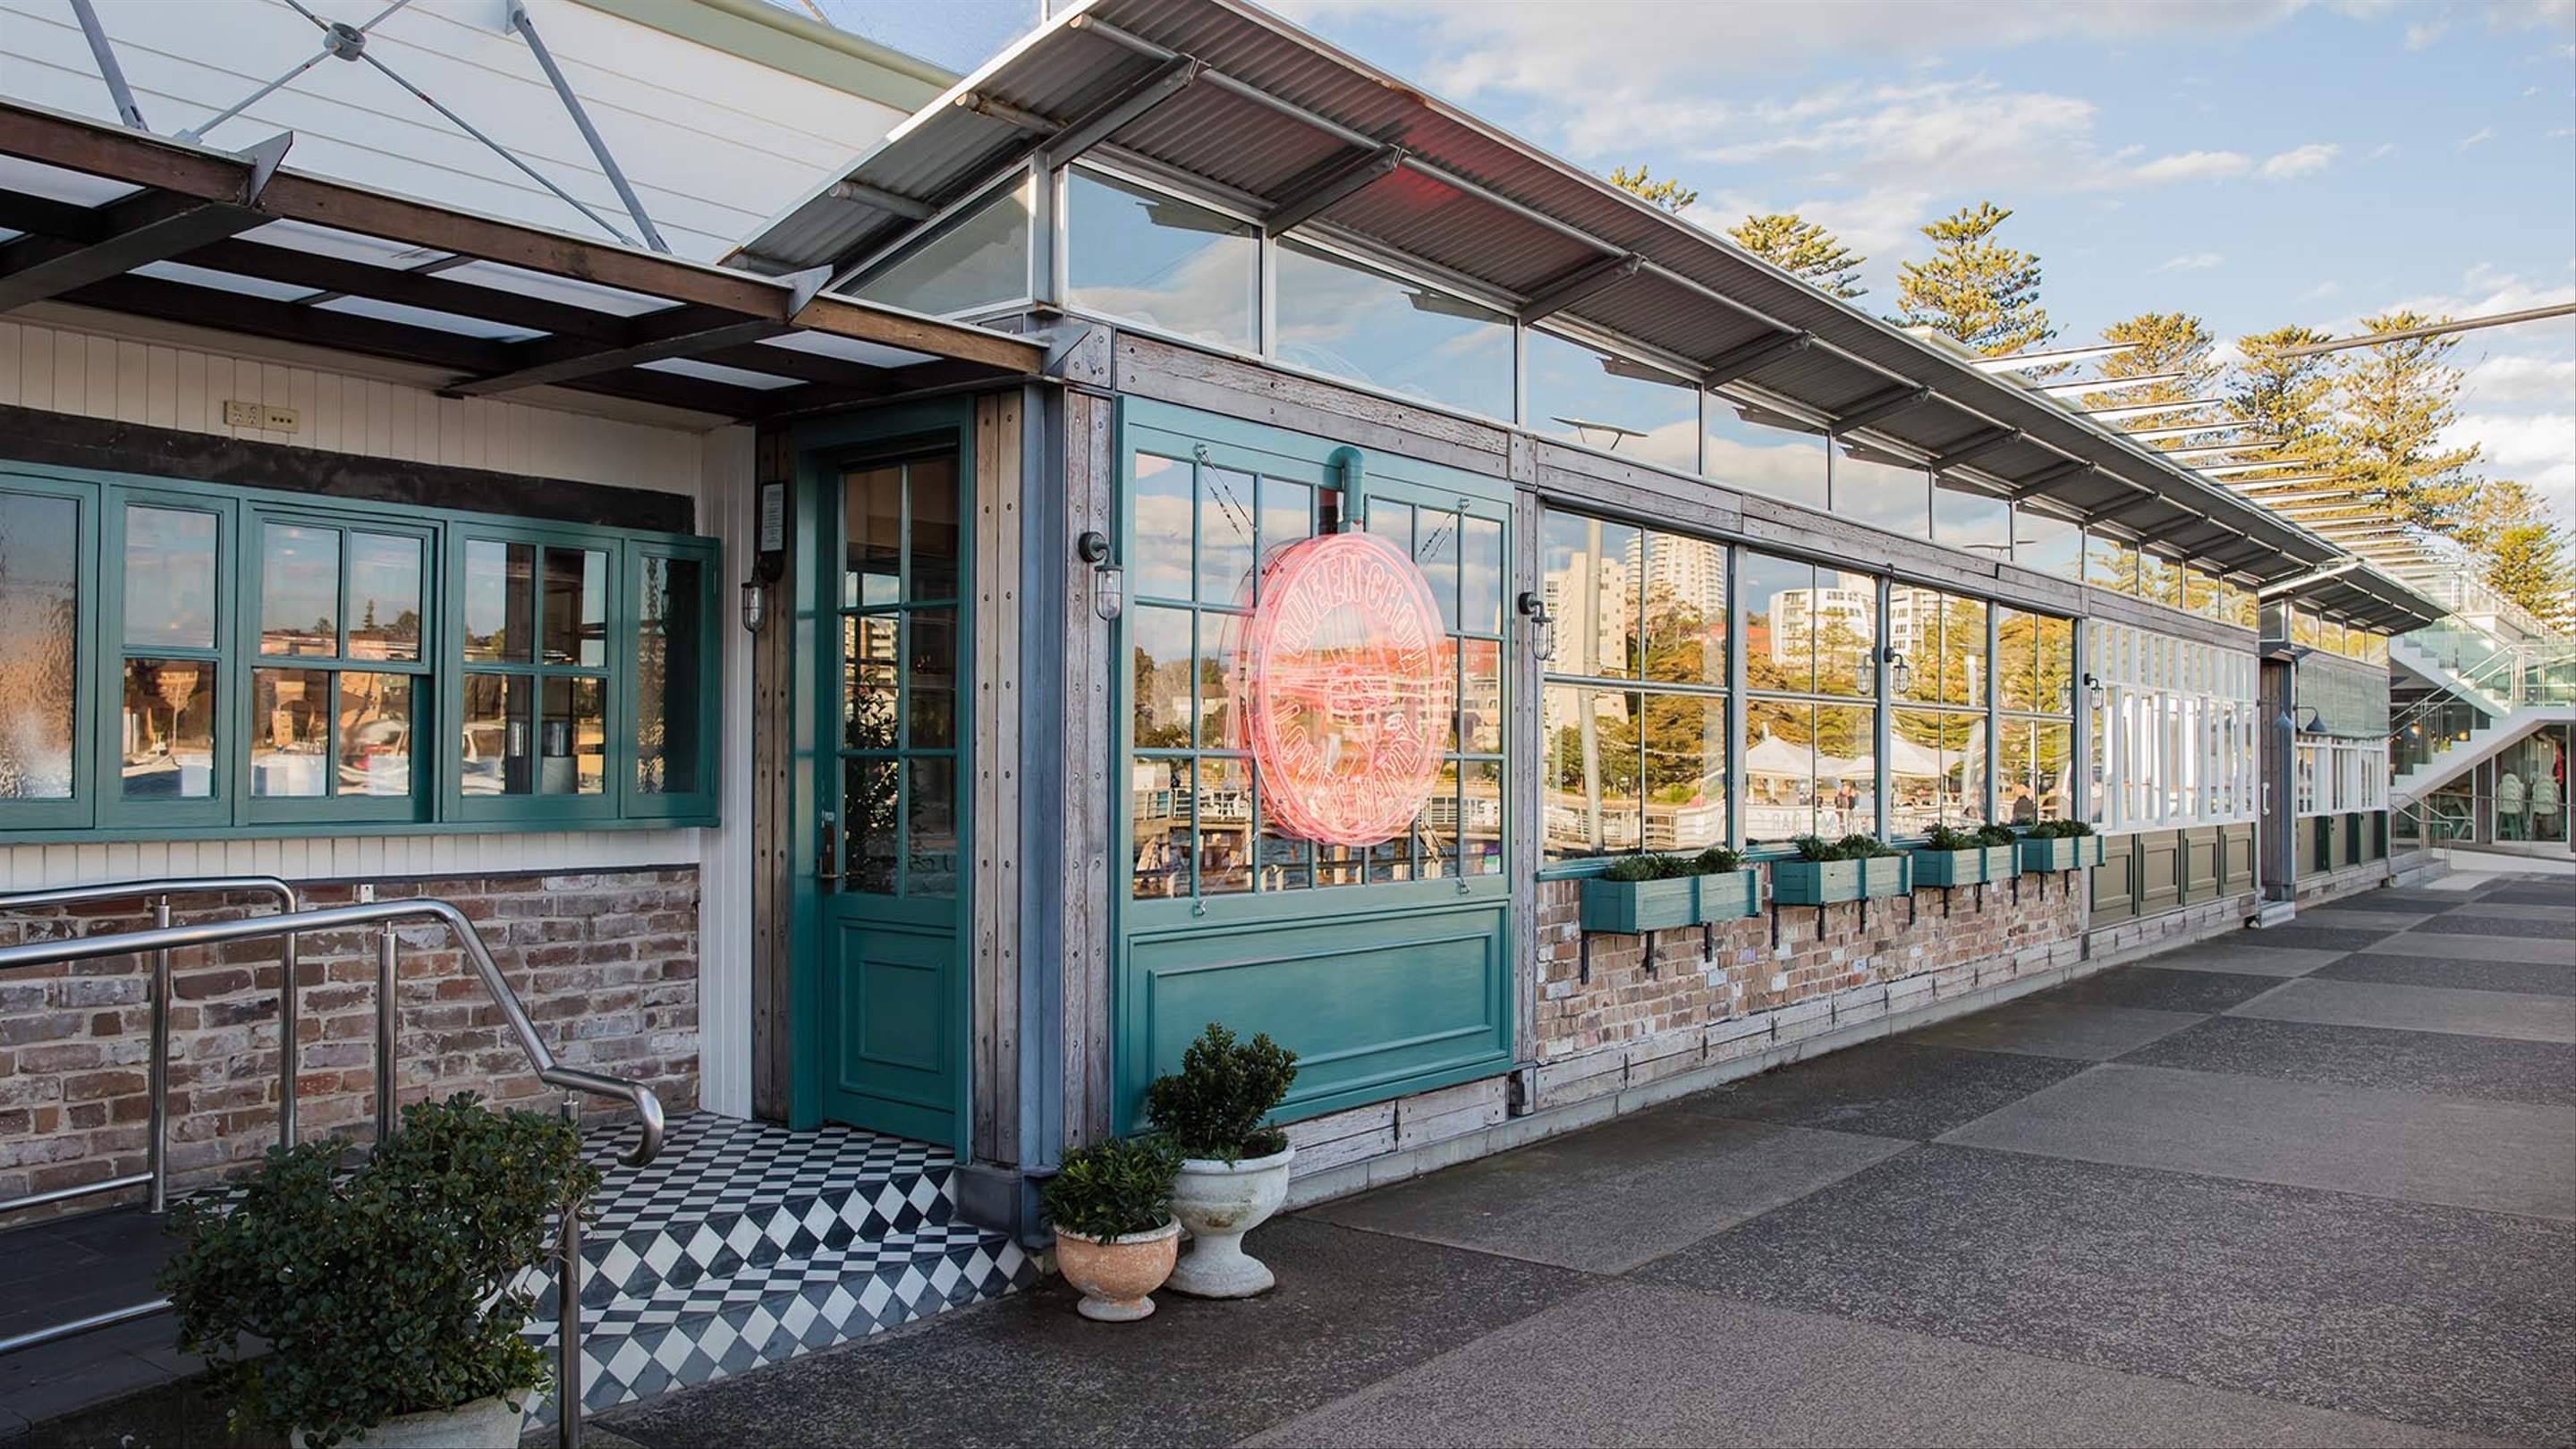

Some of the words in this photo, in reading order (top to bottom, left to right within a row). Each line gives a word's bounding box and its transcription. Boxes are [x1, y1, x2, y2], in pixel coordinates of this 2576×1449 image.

[1276, 554, 1361, 658] QUEEN
[1365, 562, 1428, 673] CHOW
[1274, 704, 1349, 822] LOVES
[1355, 713, 1424, 822] MANLY
